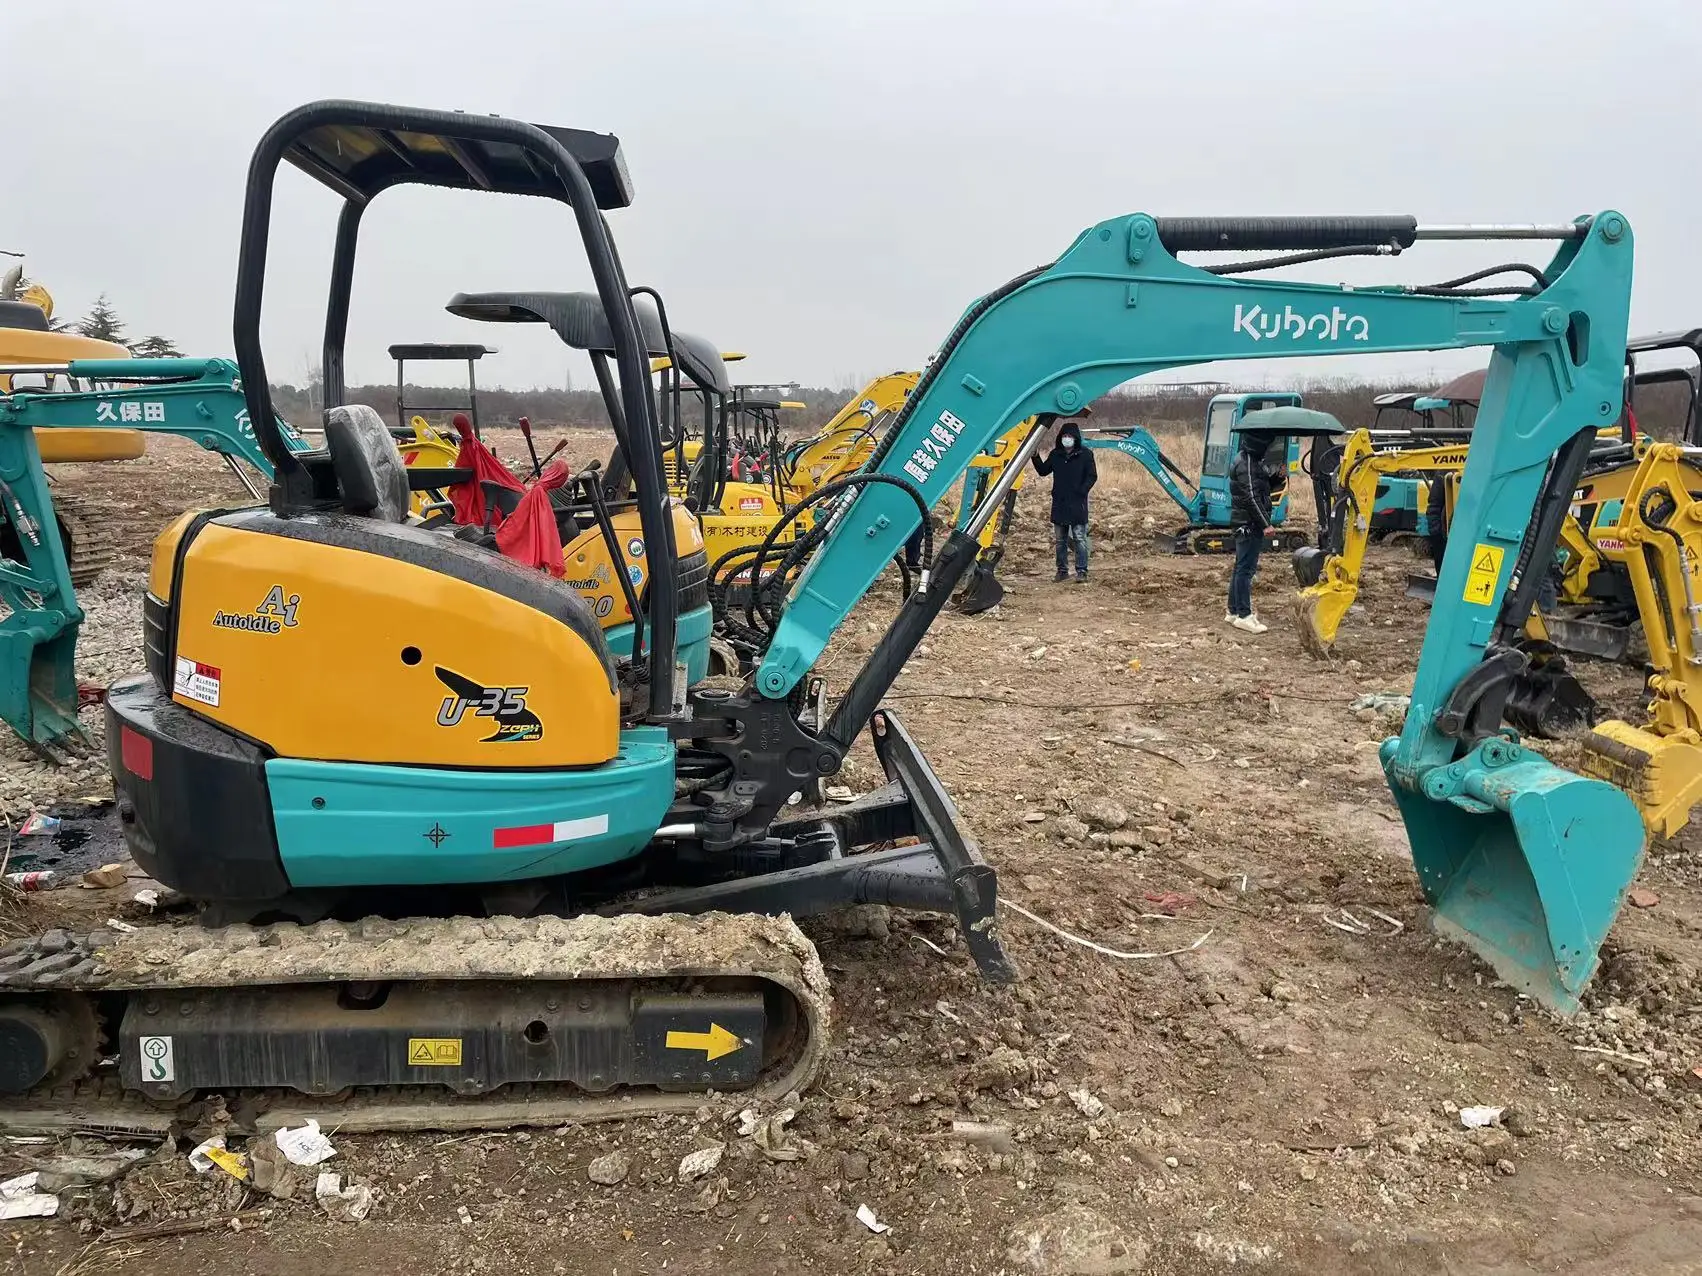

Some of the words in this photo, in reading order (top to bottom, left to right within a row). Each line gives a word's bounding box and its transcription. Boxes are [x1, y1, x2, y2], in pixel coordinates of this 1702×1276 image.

[1233, 304, 1369, 341] Kubota
[96, 402, 166, 422] 久保田
[903, 408, 966, 484] 原装久保田
[1118, 441, 1145, 455] Kubota
[437, 687, 529, 726] U-35
